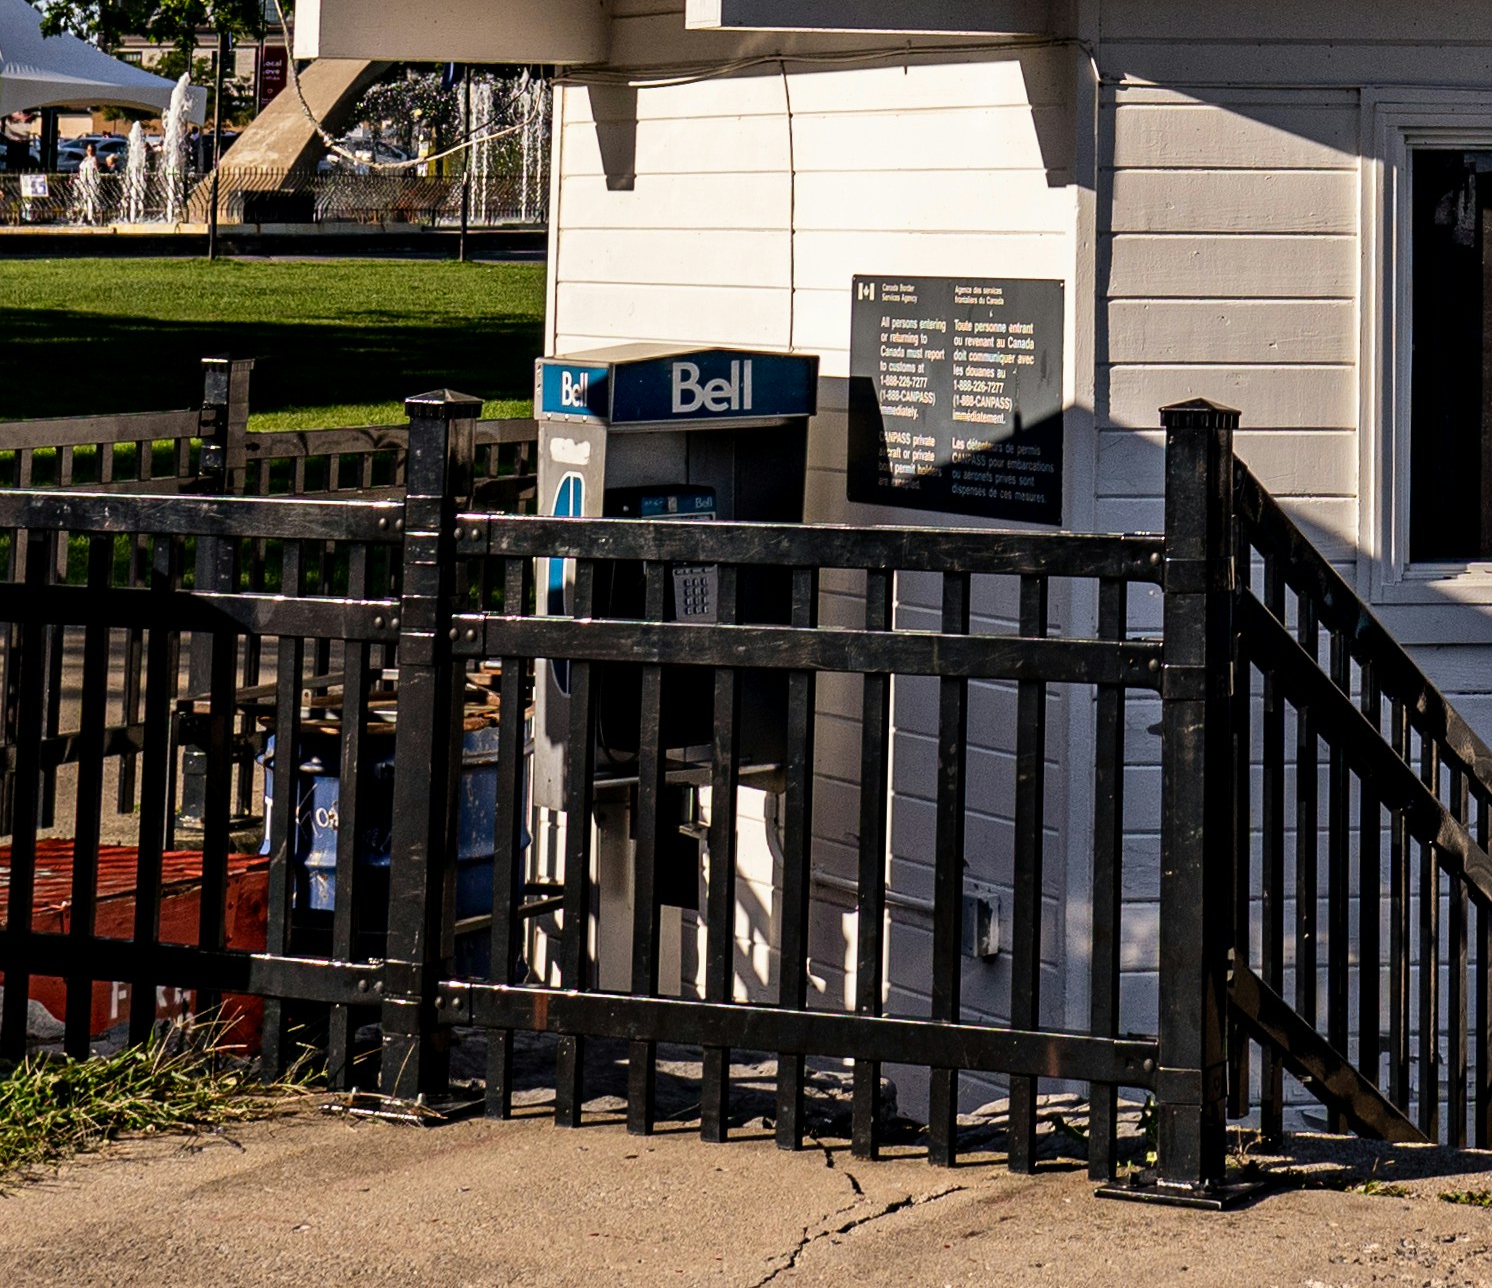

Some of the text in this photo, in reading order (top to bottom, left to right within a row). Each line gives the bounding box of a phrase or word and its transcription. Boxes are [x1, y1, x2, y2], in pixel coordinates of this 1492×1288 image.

[264, 59, 282, 67] ocal
[882, 283, 914, 292] Canada Border
[955, 285, 972, 296] Agence
[882, 293, 917, 304] Services Agency
[979, 296, 985, 304] du
[986, 296, 1004, 305] Canada
[881, 317, 946, 332] All persons entering
[954, 320, 1033, 334] Toute personne entrant
[881, 333, 927, 346] or returning to
[954, 337, 1034, 350] ou revenant au Canada
[880, 346, 945, 361] Canada must report
[954, 350, 1034, 366] doit communiquer avec
[880, 361, 924, 373] to customs at
[953, 364, 1006, 378] les douanes au
[561, 371, 588, 408] Bell
[672, 360, 752, 413] Bell
[880, 376, 928, 388] 1-888-226-7277
[954, 380, 1004, 393] 1-888-226-7277
[880, 389, 935, 406] (1-888-CANPASS)
[953, 394, 1013, 411] (1-888-CANPASS)
[880, 406, 918, 420] immediately.
[953, 409, 1005, 424] immédiatement.
[879, 432, 935, 448] CANPASS private
[952, 437, 1041, 457] Les détenteurs de permis
[879, 447, 934, 463] aircraft or private
[879, 462, 942, 478] boat permit holders
[952, 453, 1054, 473] CANPASS pour embarcations
[952, 470, 961, 479] ou
[1019, 474, 1034, 486] sont
[695, 497, 713, 509] Bell
[988, 488, 998, 499] de
[1000, 490, 1012, 499] ces
[1014, 492, 1048, 503] mesures.
